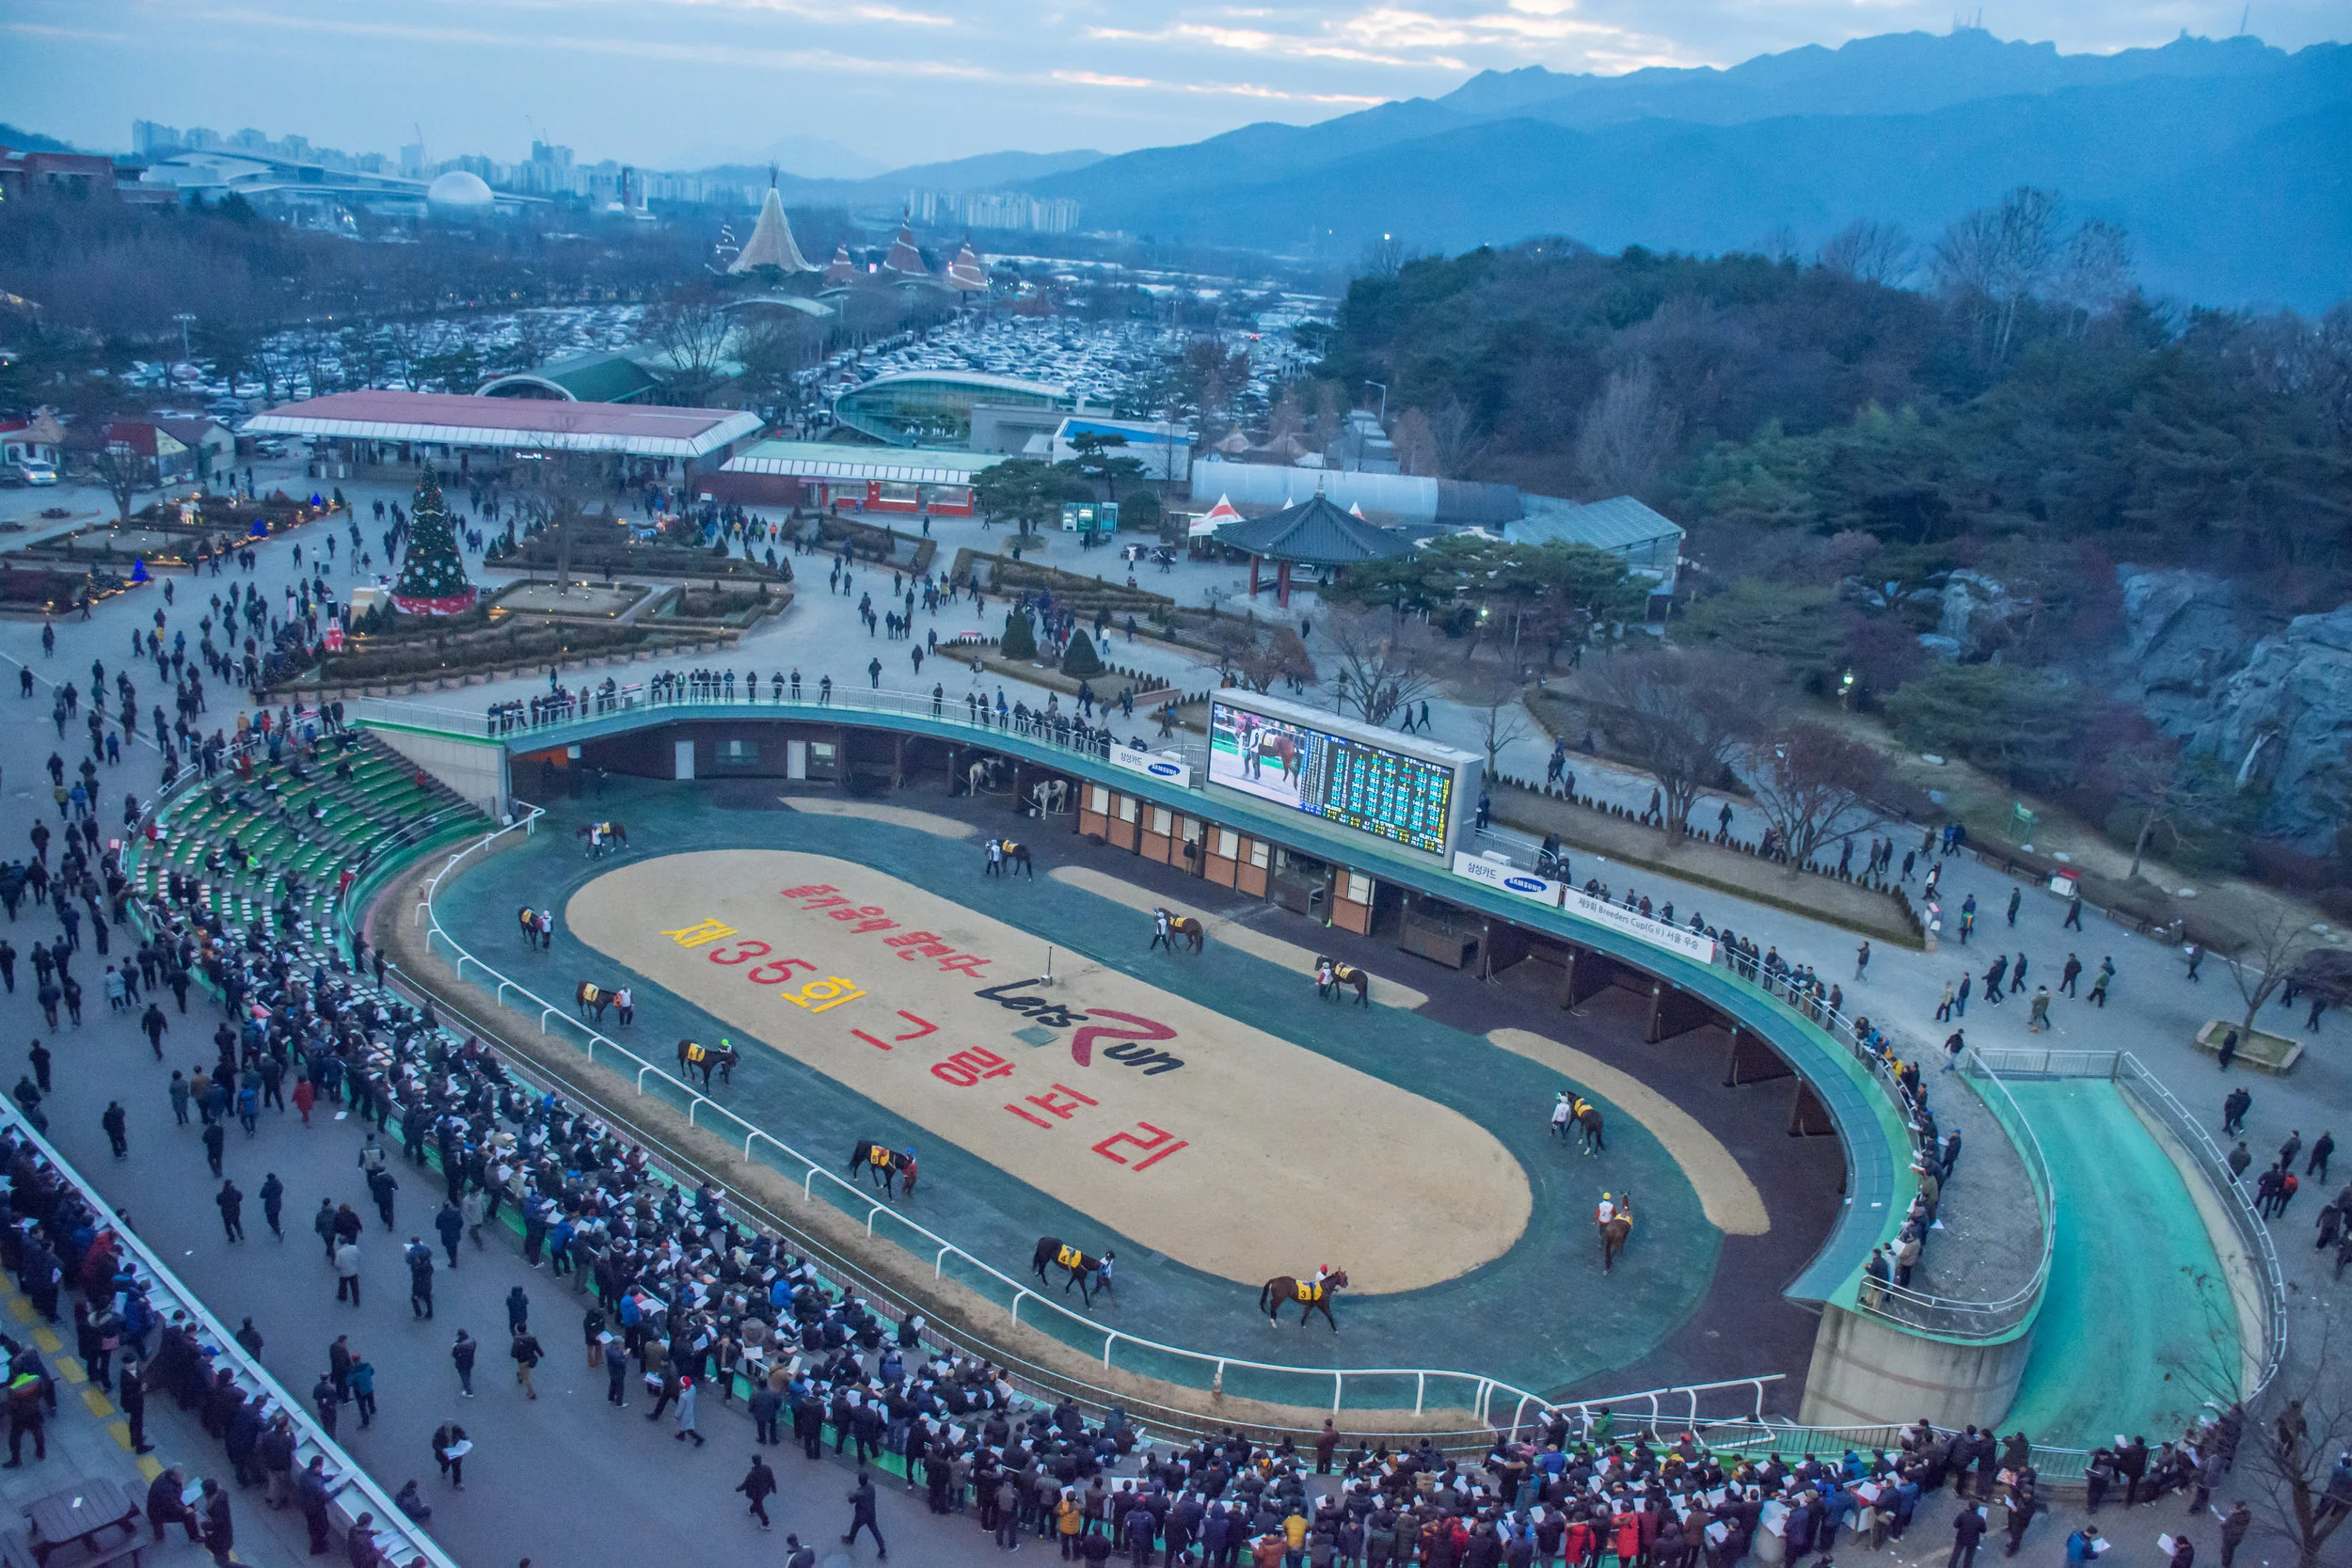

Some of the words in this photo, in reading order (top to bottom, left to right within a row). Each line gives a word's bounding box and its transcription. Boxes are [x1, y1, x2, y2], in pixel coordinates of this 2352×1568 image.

[1120, 752, 1143, 767] 삼성카드
[1468, 862, 1498, 879] 삼성카드
[1508, 878, 1543, 893] SAMSUNG
[1578, 896, 1597, 912] 제9회
[1598, 905, 1629, 925] Breeders
[1666, 931, 1682, 944] 서울
[1683, 937, 1700, 950] 우승
[660, 918, 867, 1014] 제35회
[850, 1009, 1189, 1172] 그랑프리
[1300, 1291, 1306, 1299] 3
